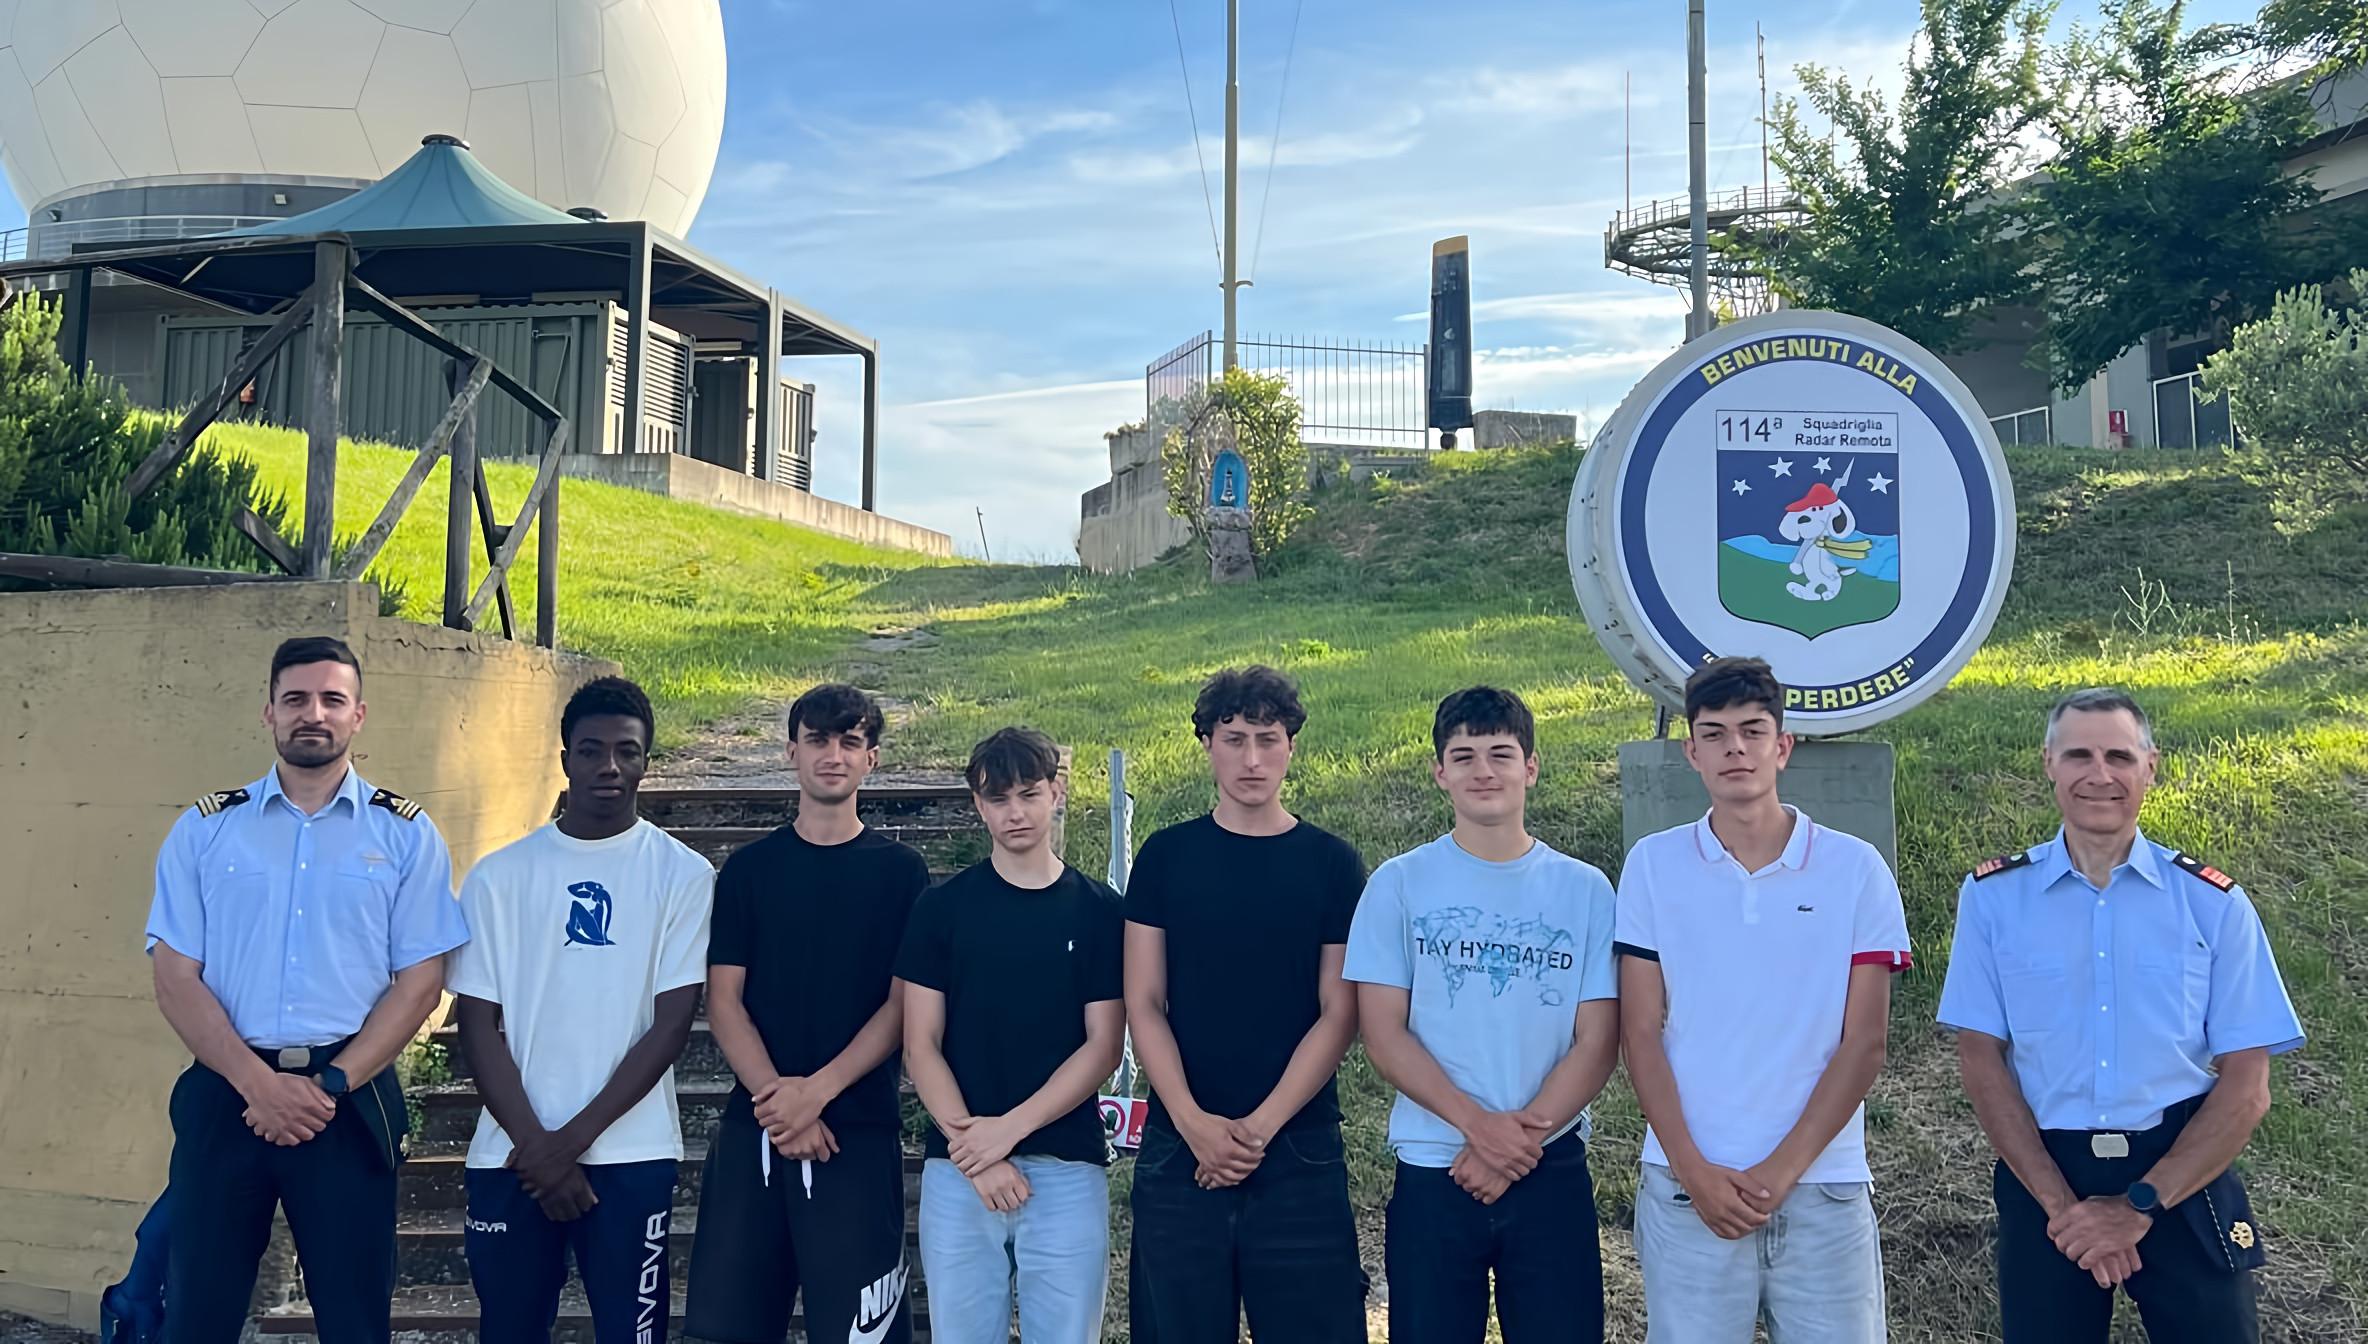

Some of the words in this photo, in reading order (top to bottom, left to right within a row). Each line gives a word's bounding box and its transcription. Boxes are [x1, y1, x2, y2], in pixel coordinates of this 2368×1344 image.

[1701, 338, 1850, 385] BENVENUTI
[1856, 351, 1918, 395] ALLA
[1803, 417, 1883, 432] Squadriglia
[1795, 433, 1836, 446] Radar
[1840, 434, 1892, 447] Remota
